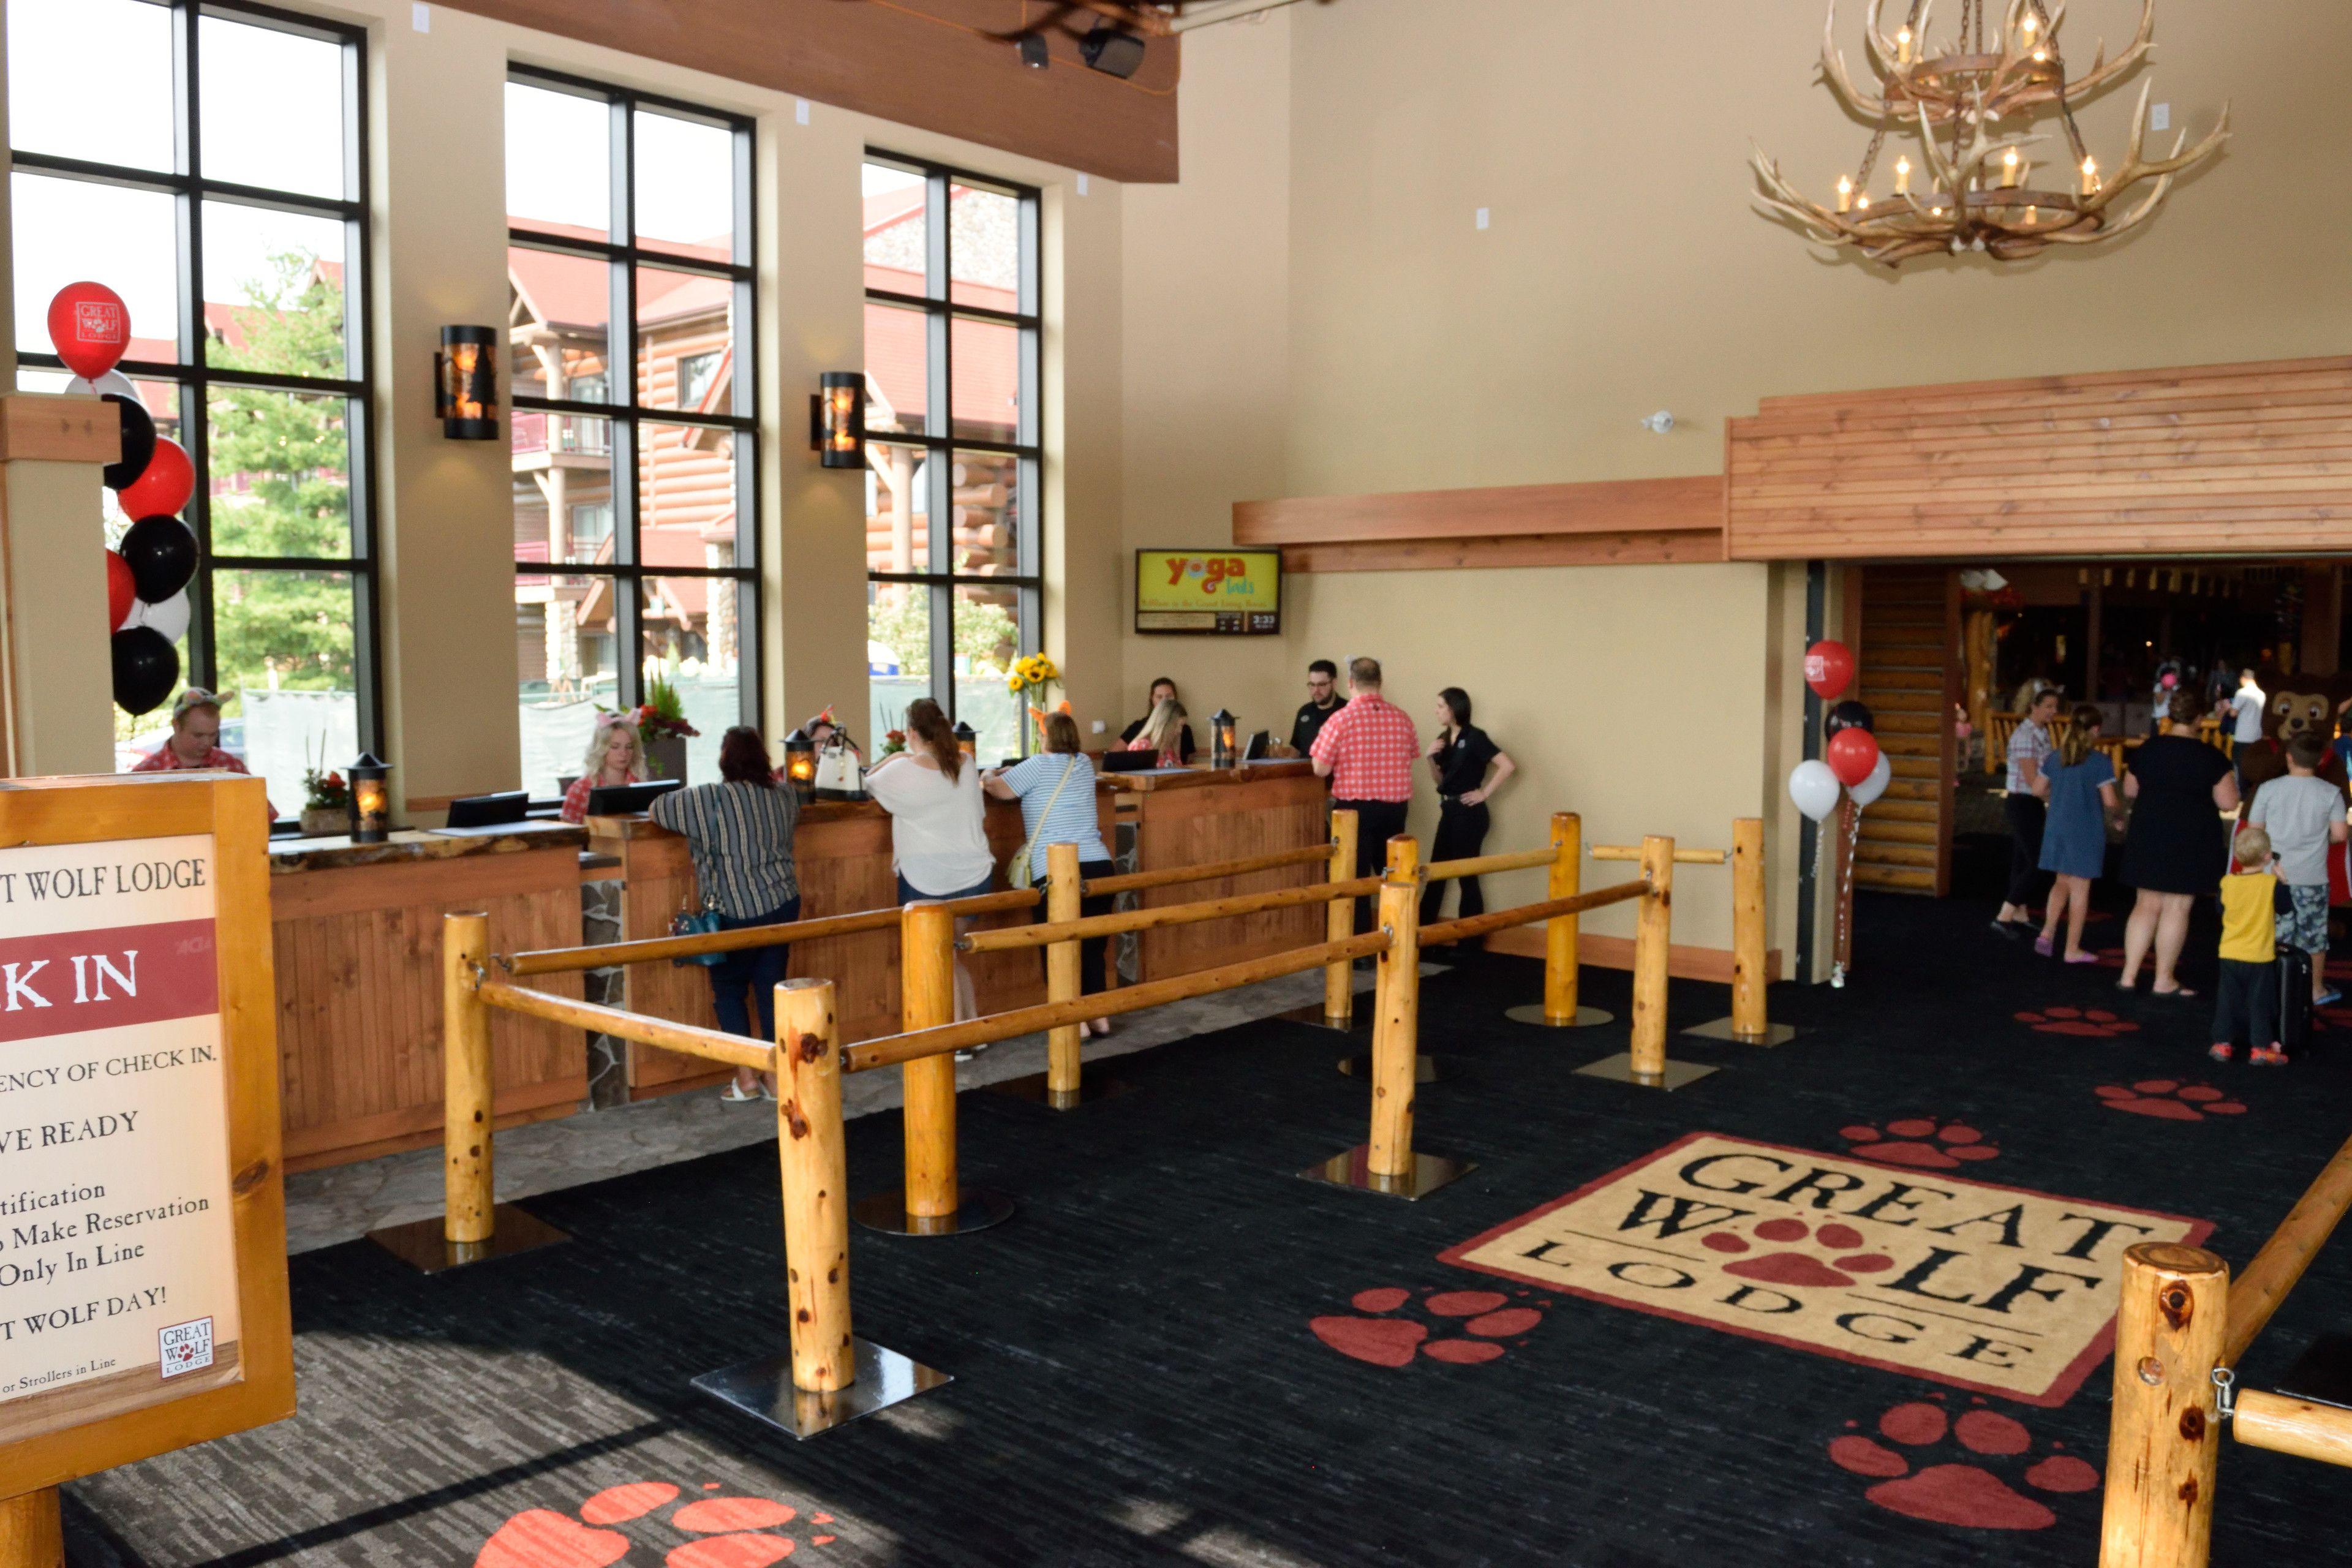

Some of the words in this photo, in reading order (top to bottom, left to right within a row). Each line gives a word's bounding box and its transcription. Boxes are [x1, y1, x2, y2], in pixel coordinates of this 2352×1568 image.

[1166, 557, 1246, 594] yoga
[25, 866, 108, 901] WOLF
[116, 858, 205, 893] LODGE
[69, 950, 138, 1004] IN
[67, 1061, 99, 1083] OF
[105, 1049, 184, 1077] CHECK
[190, 1046, 217, 1063] IN.
[40, 1110, 138, 1147] READY
[0, 1183, 106, 1216] tification
[1678, 1153, 2154, 1262] GREAT
[12, 1220, 78, 1249] Make
[85, 1197, 209, 1235] Reservation
[0, 1257, 58, 1287] Only
[67, 1251, 89, 1273] In
[96, 1243, 145, 1266] Line
[23, 1300, 100, 1335] WOLF
[106, 1286, 167, 1316] DAY!
[1514, 1240, 2034, 1369] LODGE
[164, 1321, 210, 1346] GREAT
[2, 1384, 15, 1393] or
[19, 1370, 72, 1390] Strollers
[75, 1365, 87, 1376] in
[91, 1358, 116, 1372] Line
[166, 1355, 211, 1374] LODGE
